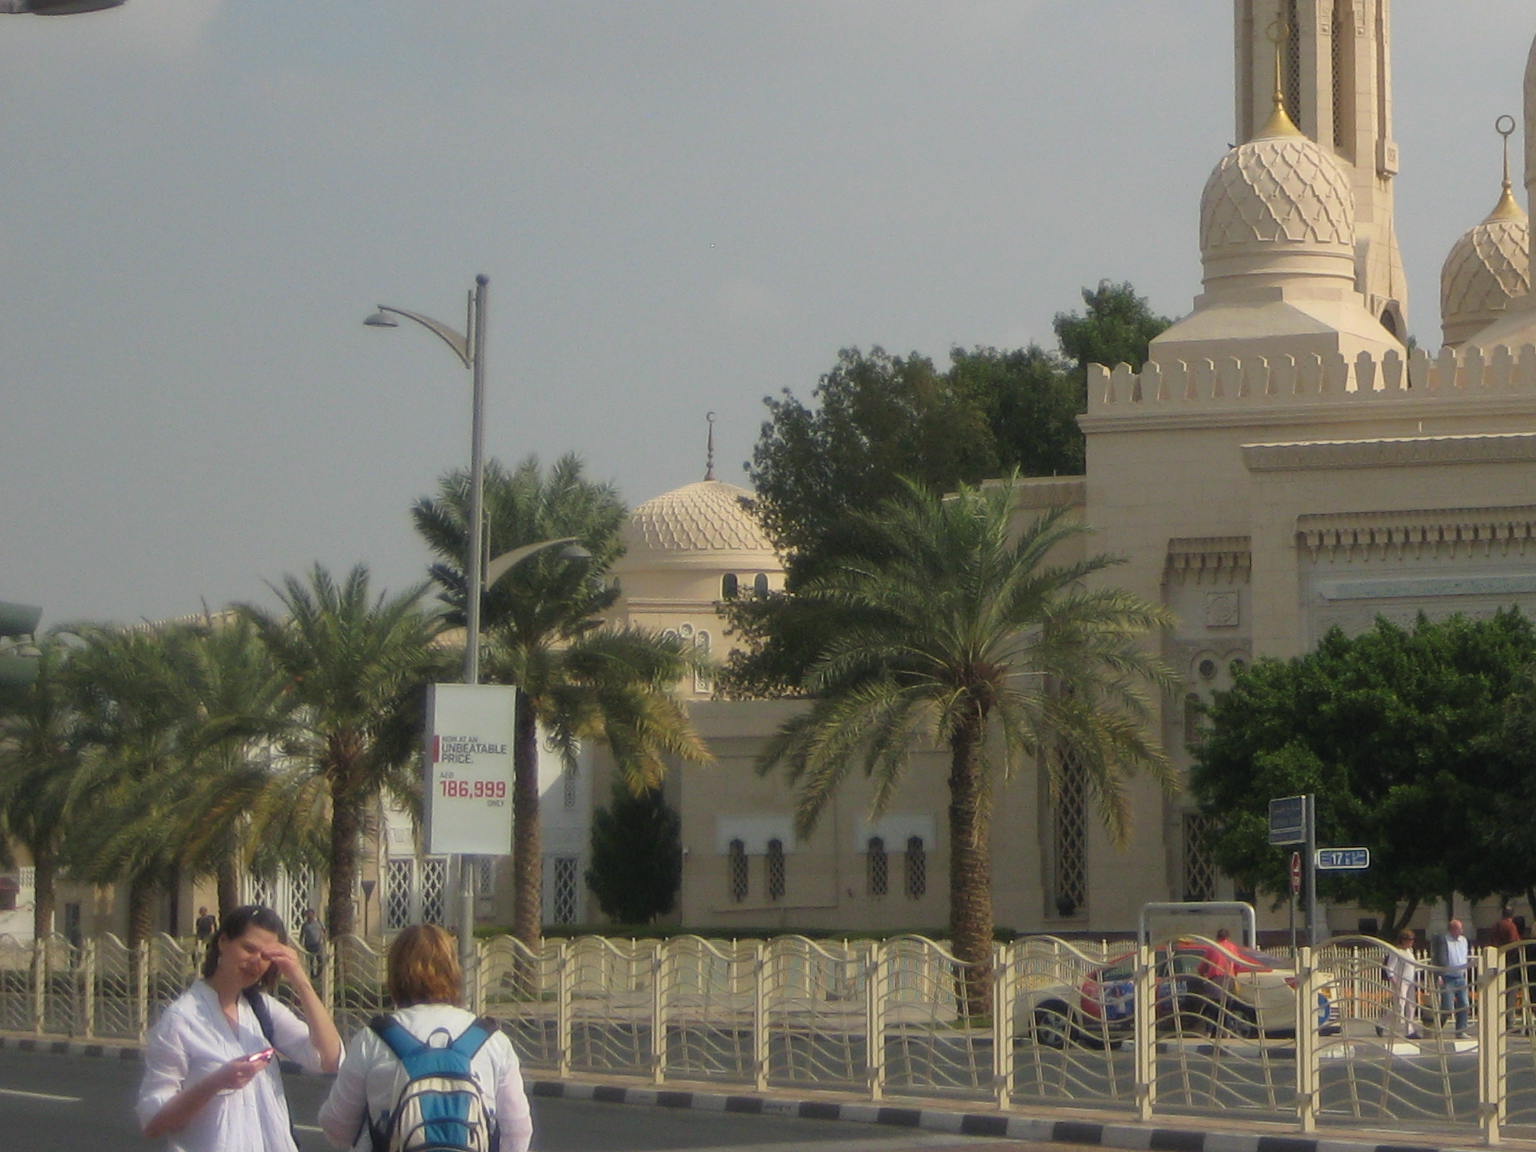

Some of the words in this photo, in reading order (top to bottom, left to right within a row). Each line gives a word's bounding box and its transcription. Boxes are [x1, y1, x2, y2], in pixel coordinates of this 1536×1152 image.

[442, 743, 507, 754] UNBEATABLE
[440, 780, 506, 798] 186,999
[1331, 851, 1343, 865] 17
